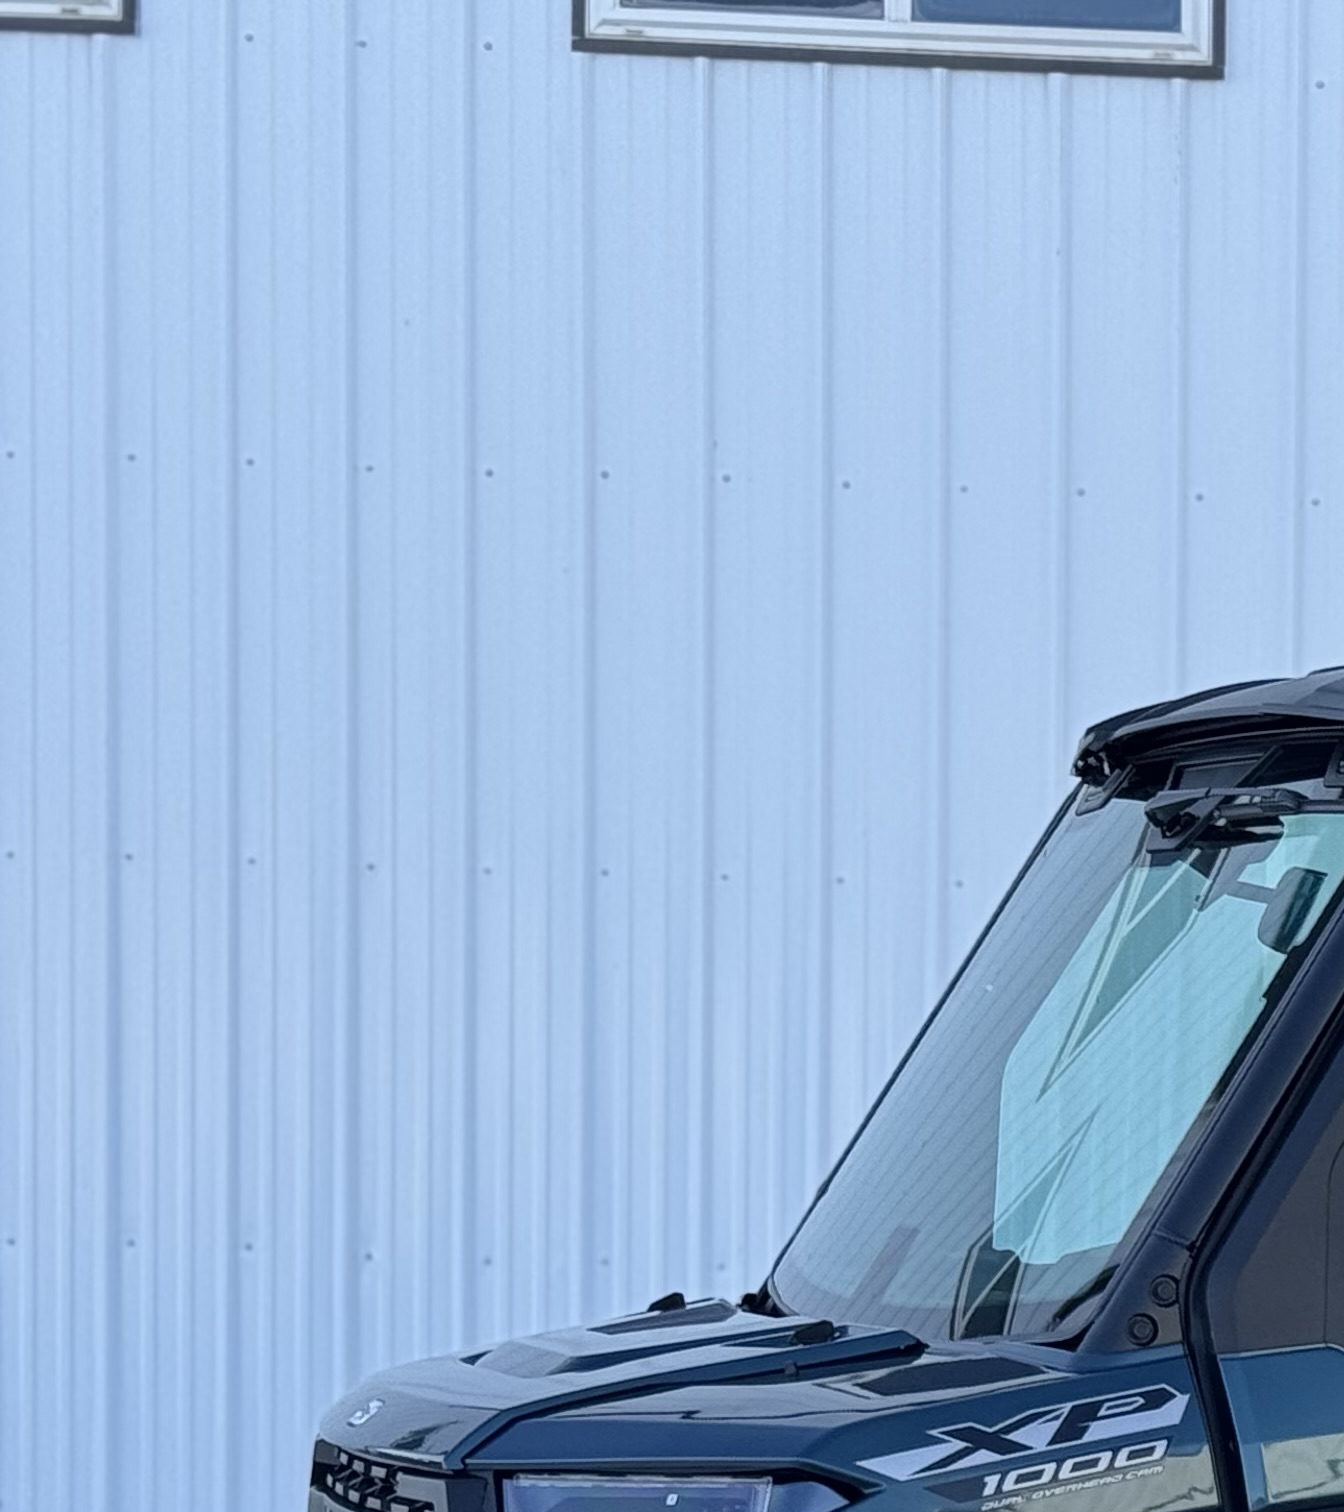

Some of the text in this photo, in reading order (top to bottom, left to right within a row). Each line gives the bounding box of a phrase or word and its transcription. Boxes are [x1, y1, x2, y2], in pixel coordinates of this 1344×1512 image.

[910, 1384, 1182, 1476] XP
[981, 1464, 1165, 1512] DUAL OVERHEAD CAM
[982, 1438, 1169, 1497] 1000
